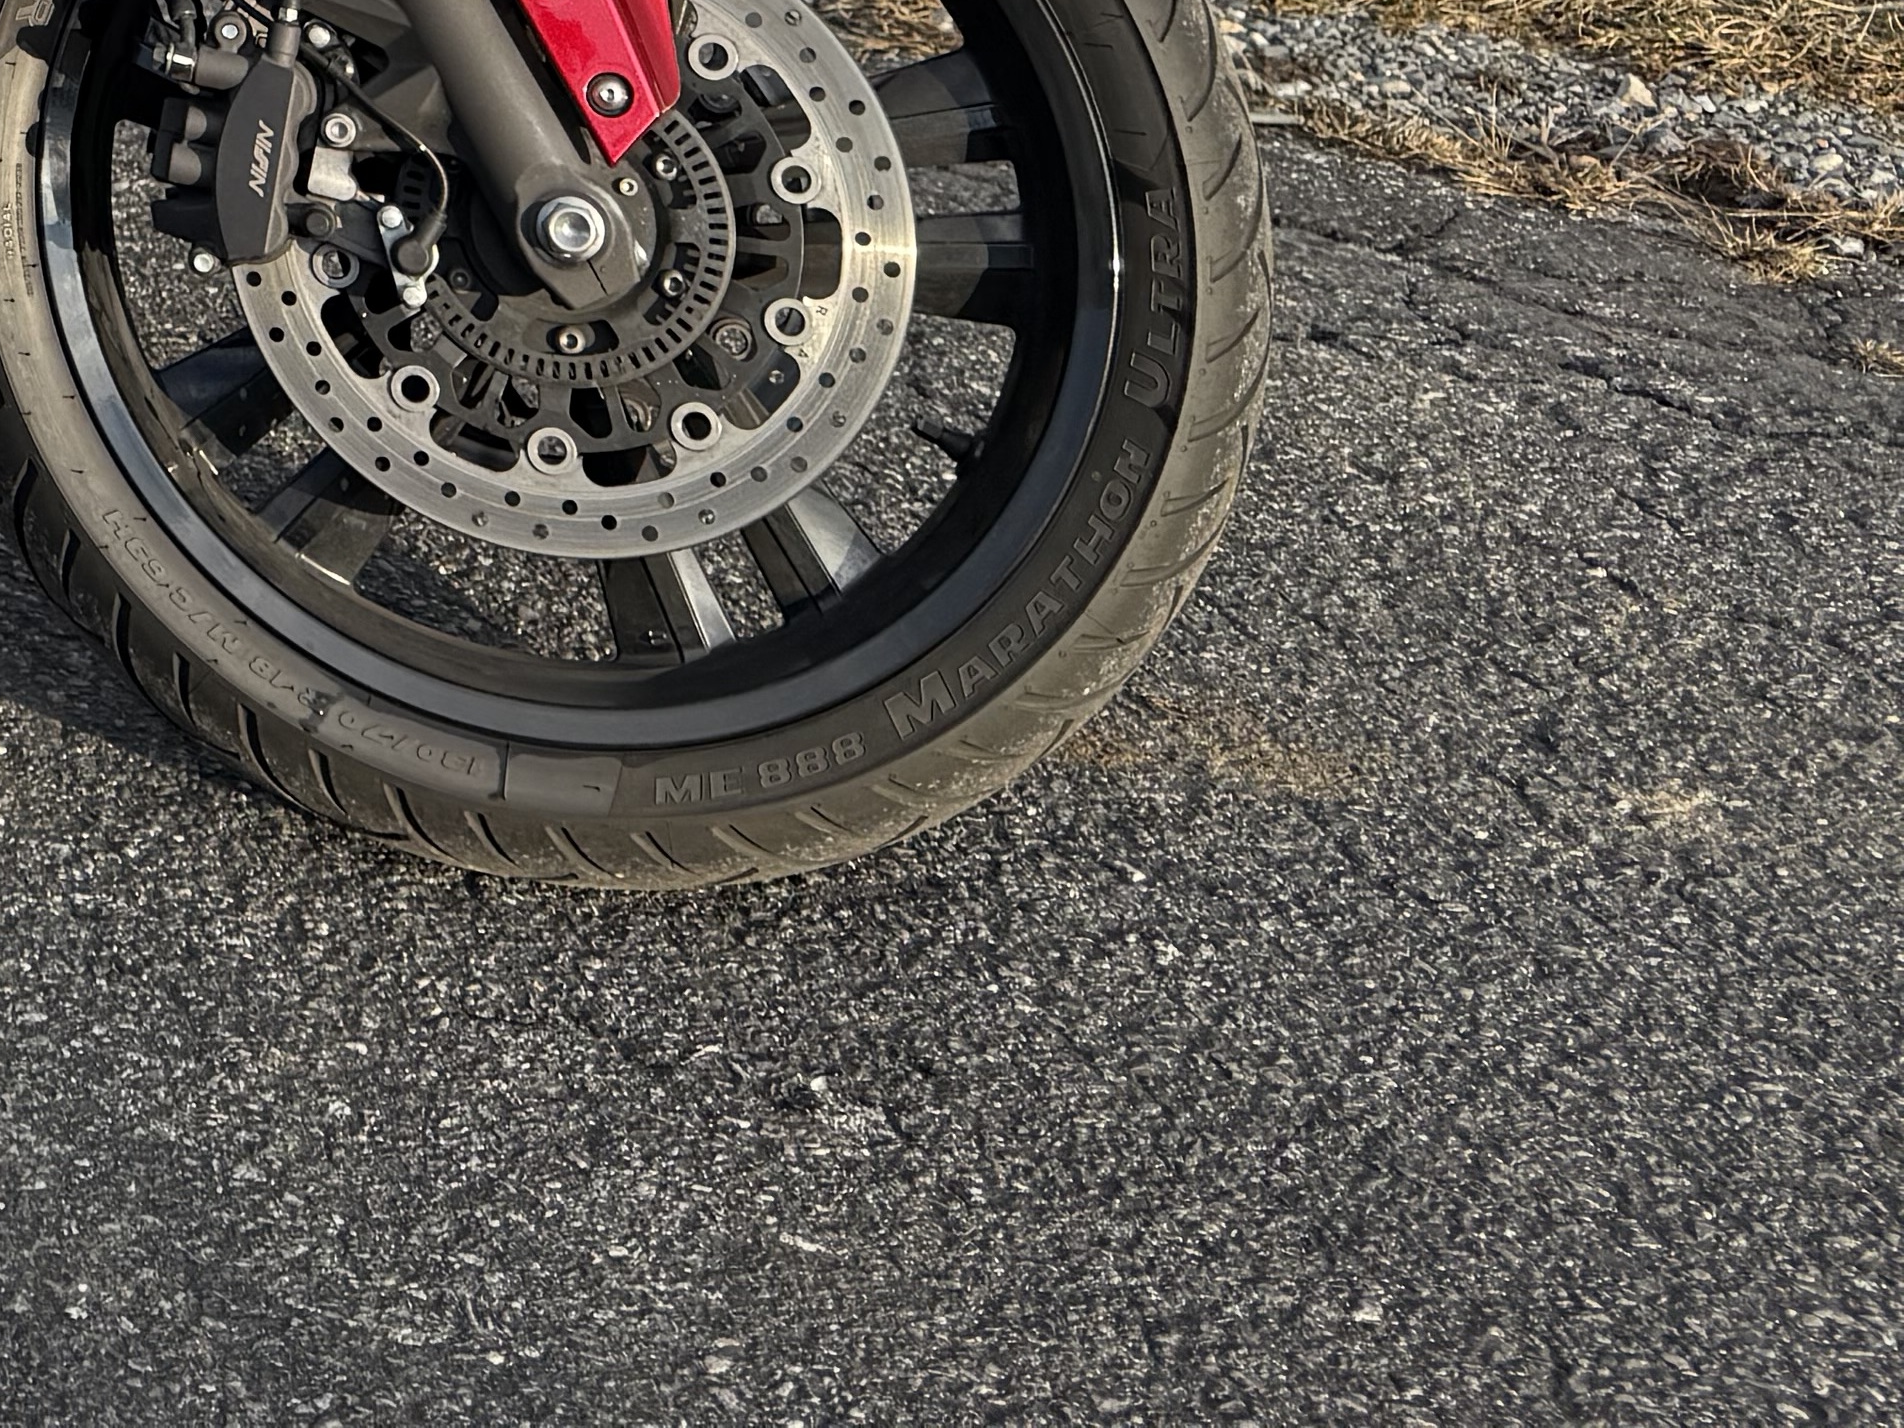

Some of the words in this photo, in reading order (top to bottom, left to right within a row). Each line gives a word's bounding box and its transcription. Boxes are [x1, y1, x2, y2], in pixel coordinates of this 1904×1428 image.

[654, 766, 744, 805] ME
[757, 731, 867, 789] 888
[883, 439, 1150, 741] MARATHON
[1122, 186, 1183, 407] ULTRA
